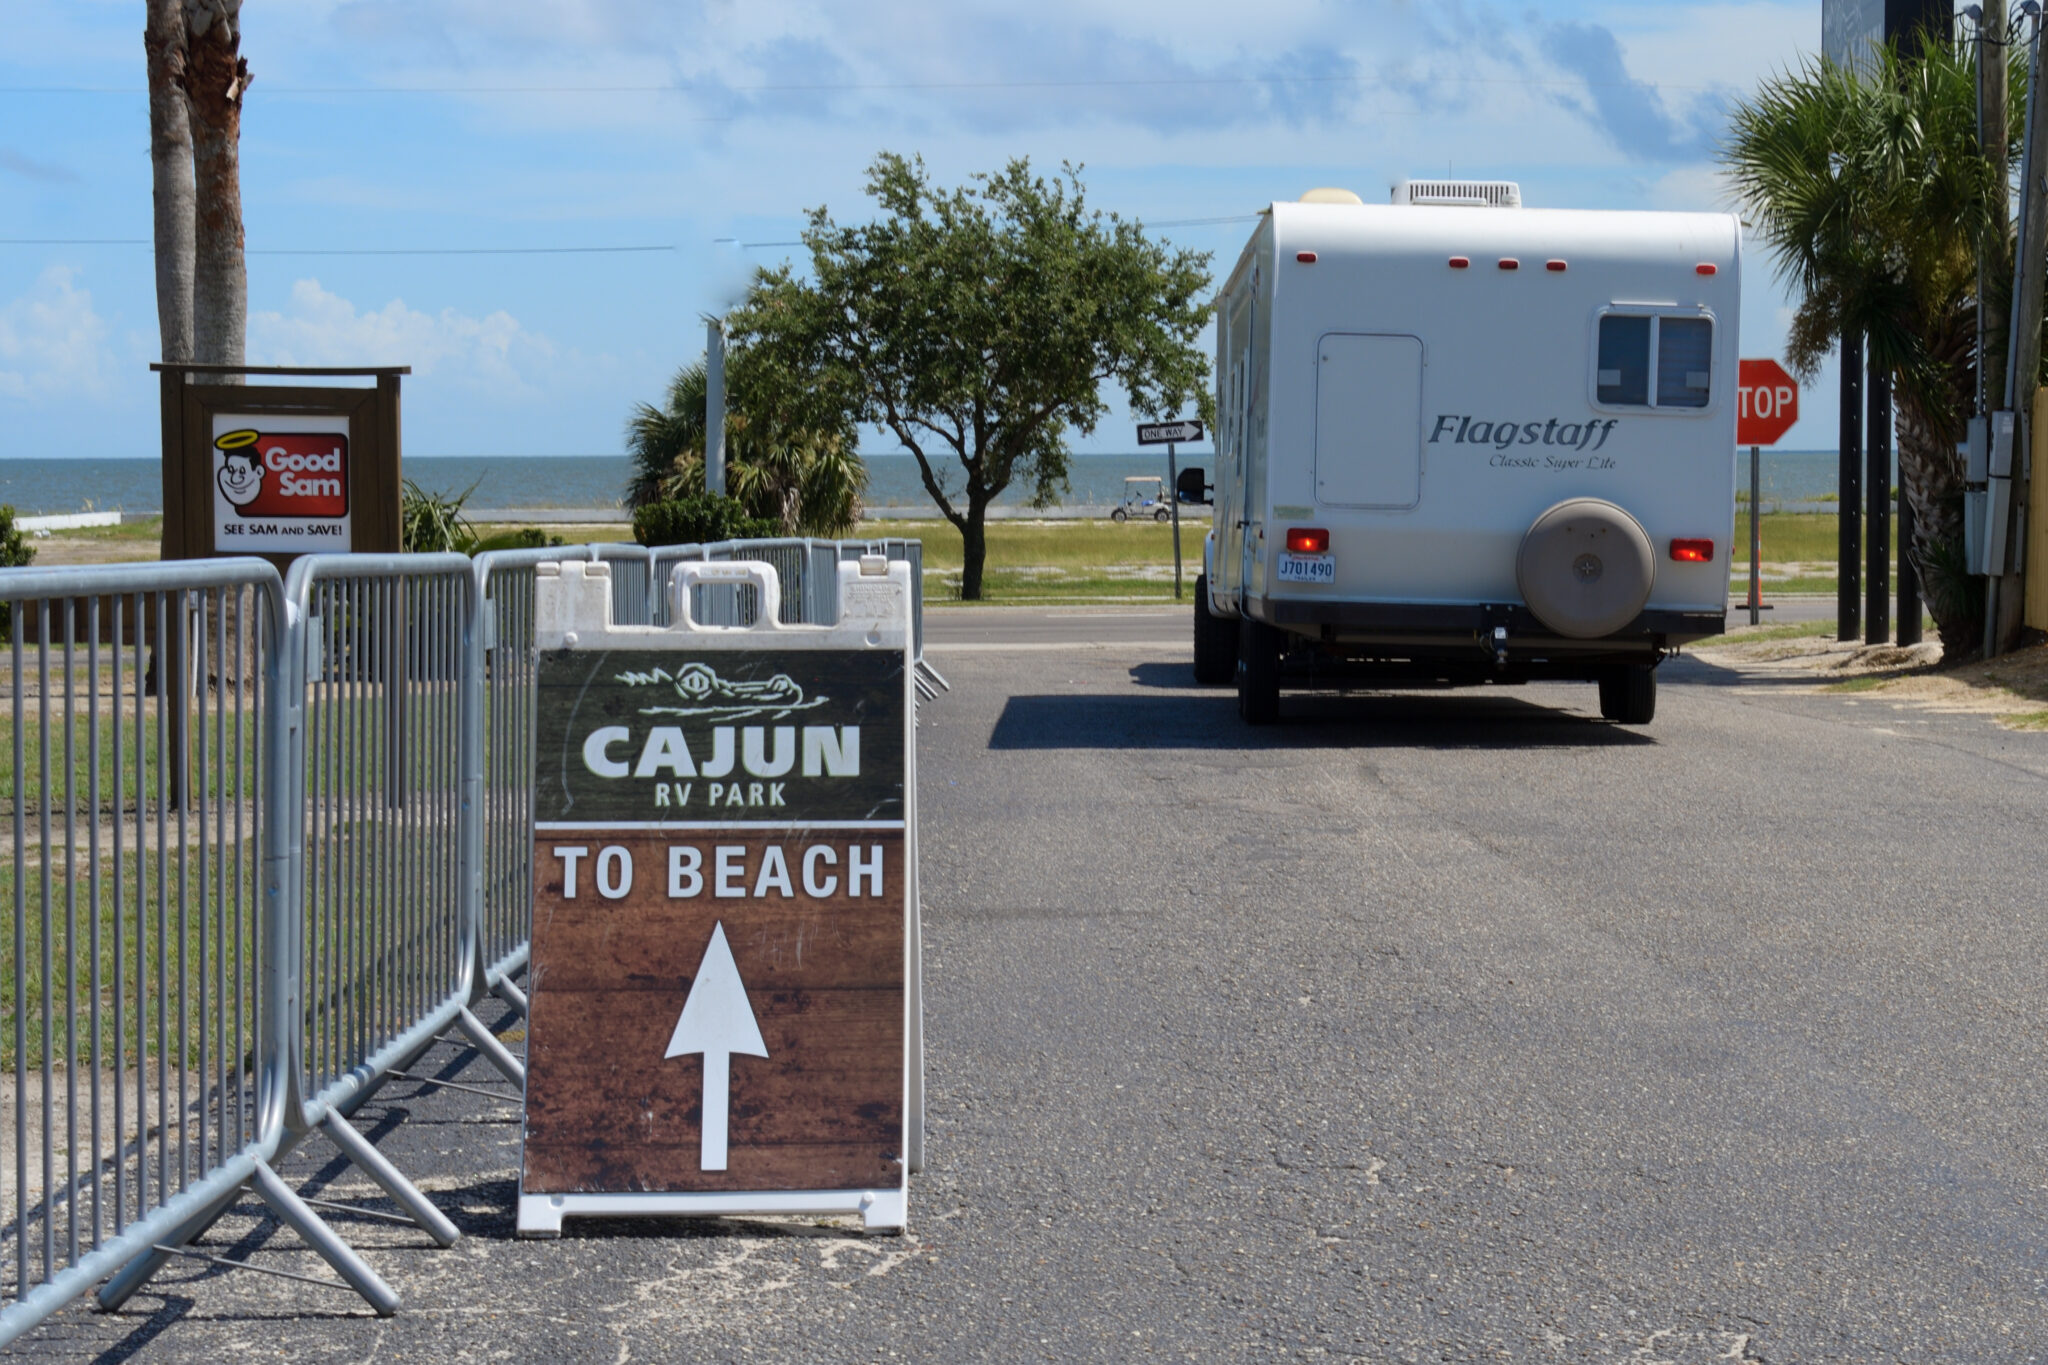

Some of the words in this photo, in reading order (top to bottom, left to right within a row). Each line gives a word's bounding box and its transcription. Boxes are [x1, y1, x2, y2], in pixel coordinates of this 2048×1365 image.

[1738, 386, 1793, 419] TOP
[1165, 426, 1183, 437] WAY
[1428, 415, 1618, 451] Flagstaff
[265, 447, 340, 472] Good
[1489, 454, 1540, 468] Classic
[1544, 456, 1583, 473] Super
[1586, 455, 1616, 470] Lite
[279, 472, 341, 497] Sam
[224, 524, 245, 536] SEE
[249, 524, 278, 536] SAM
[281, 526, 304, 536] AND
[307, 525, 342, 536] SAVE!
[1281, 560, 1332, 577] J701490
[582, 726, 860, 778] CAJUN
[655, 783, 692, 807] RV
[709, 782, 787, 807] PARK
[554, 845, 633, 899] TO
[668, 844, 884, 898] BEACH
